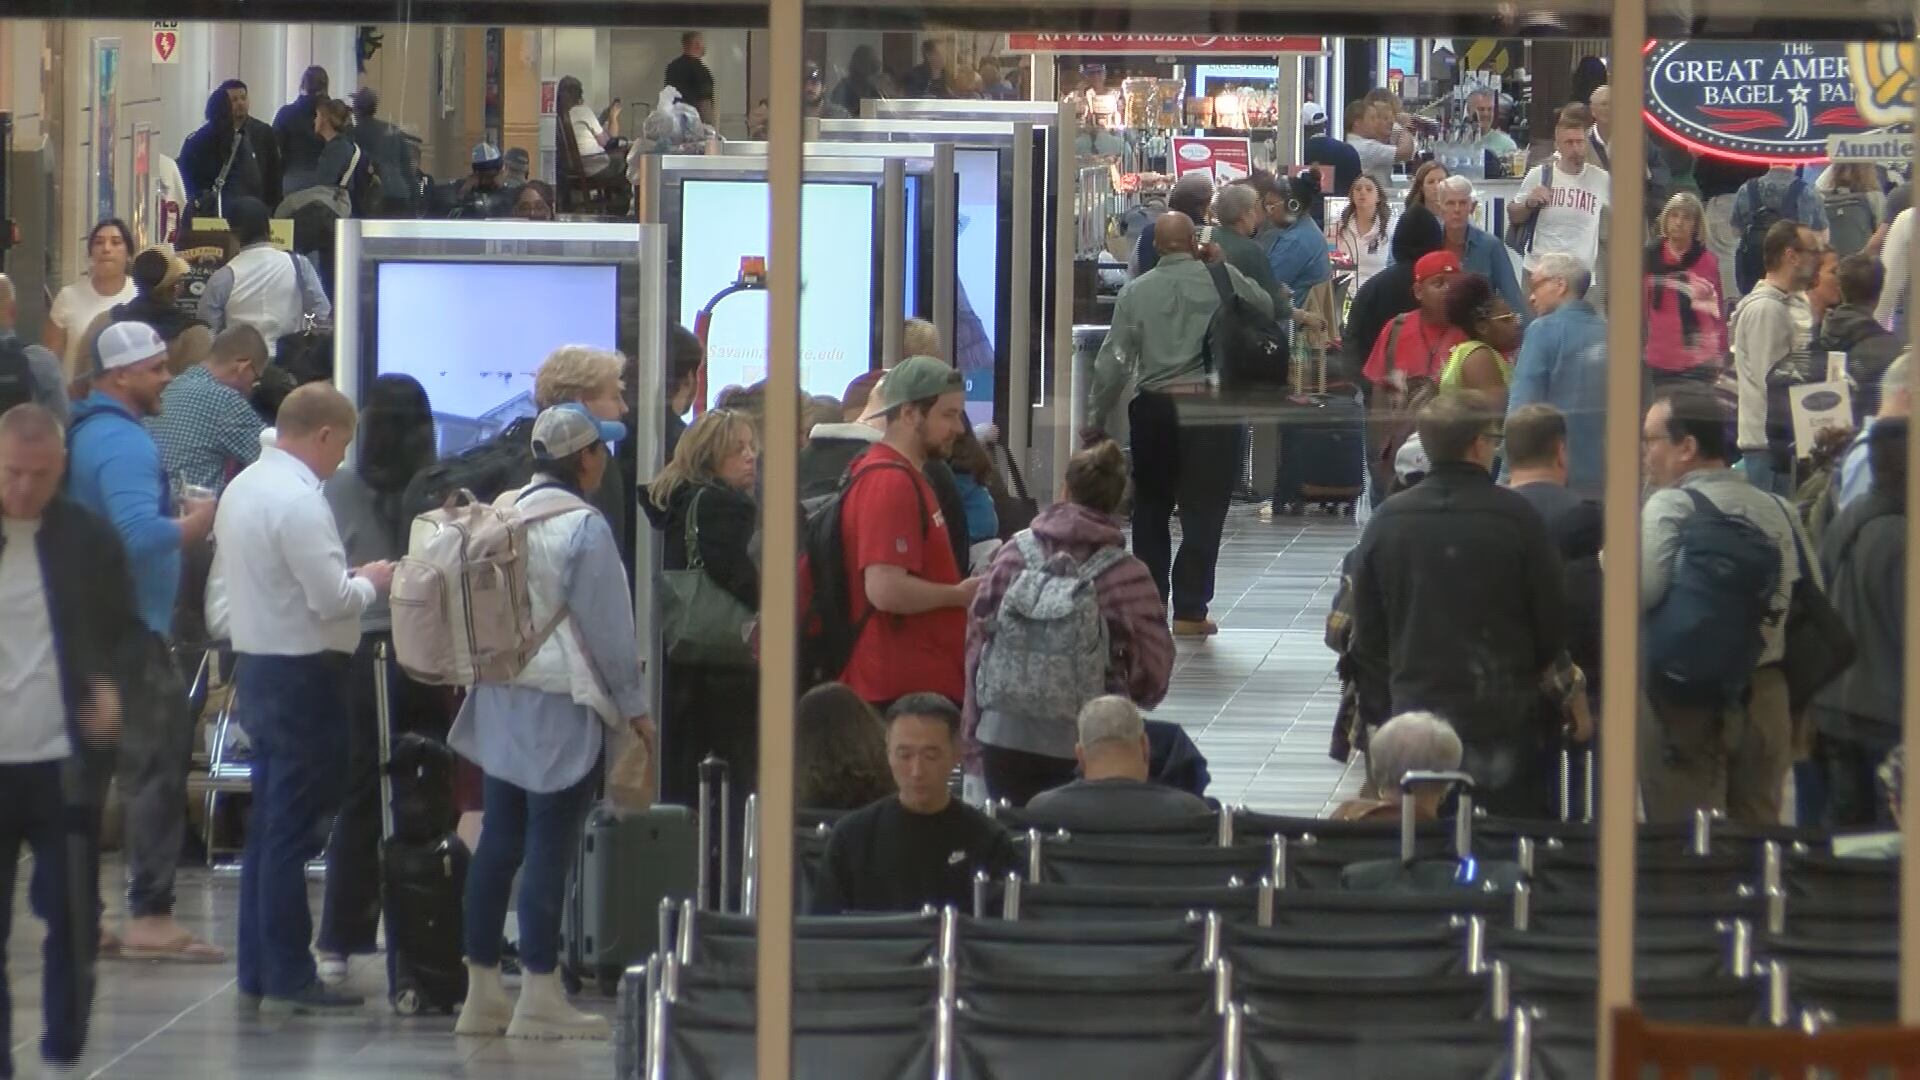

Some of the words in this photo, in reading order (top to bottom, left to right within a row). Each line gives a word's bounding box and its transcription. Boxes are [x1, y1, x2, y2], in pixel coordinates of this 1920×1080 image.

[1781, 42, 1814, 55] THE
[1665, 58, 1763, 83] GREAT
[1704, 84, 1783, 105] BAGEL
[1835, 138, 1913, 157] Auntie
[1567, 188, 1598, 215] STATE
